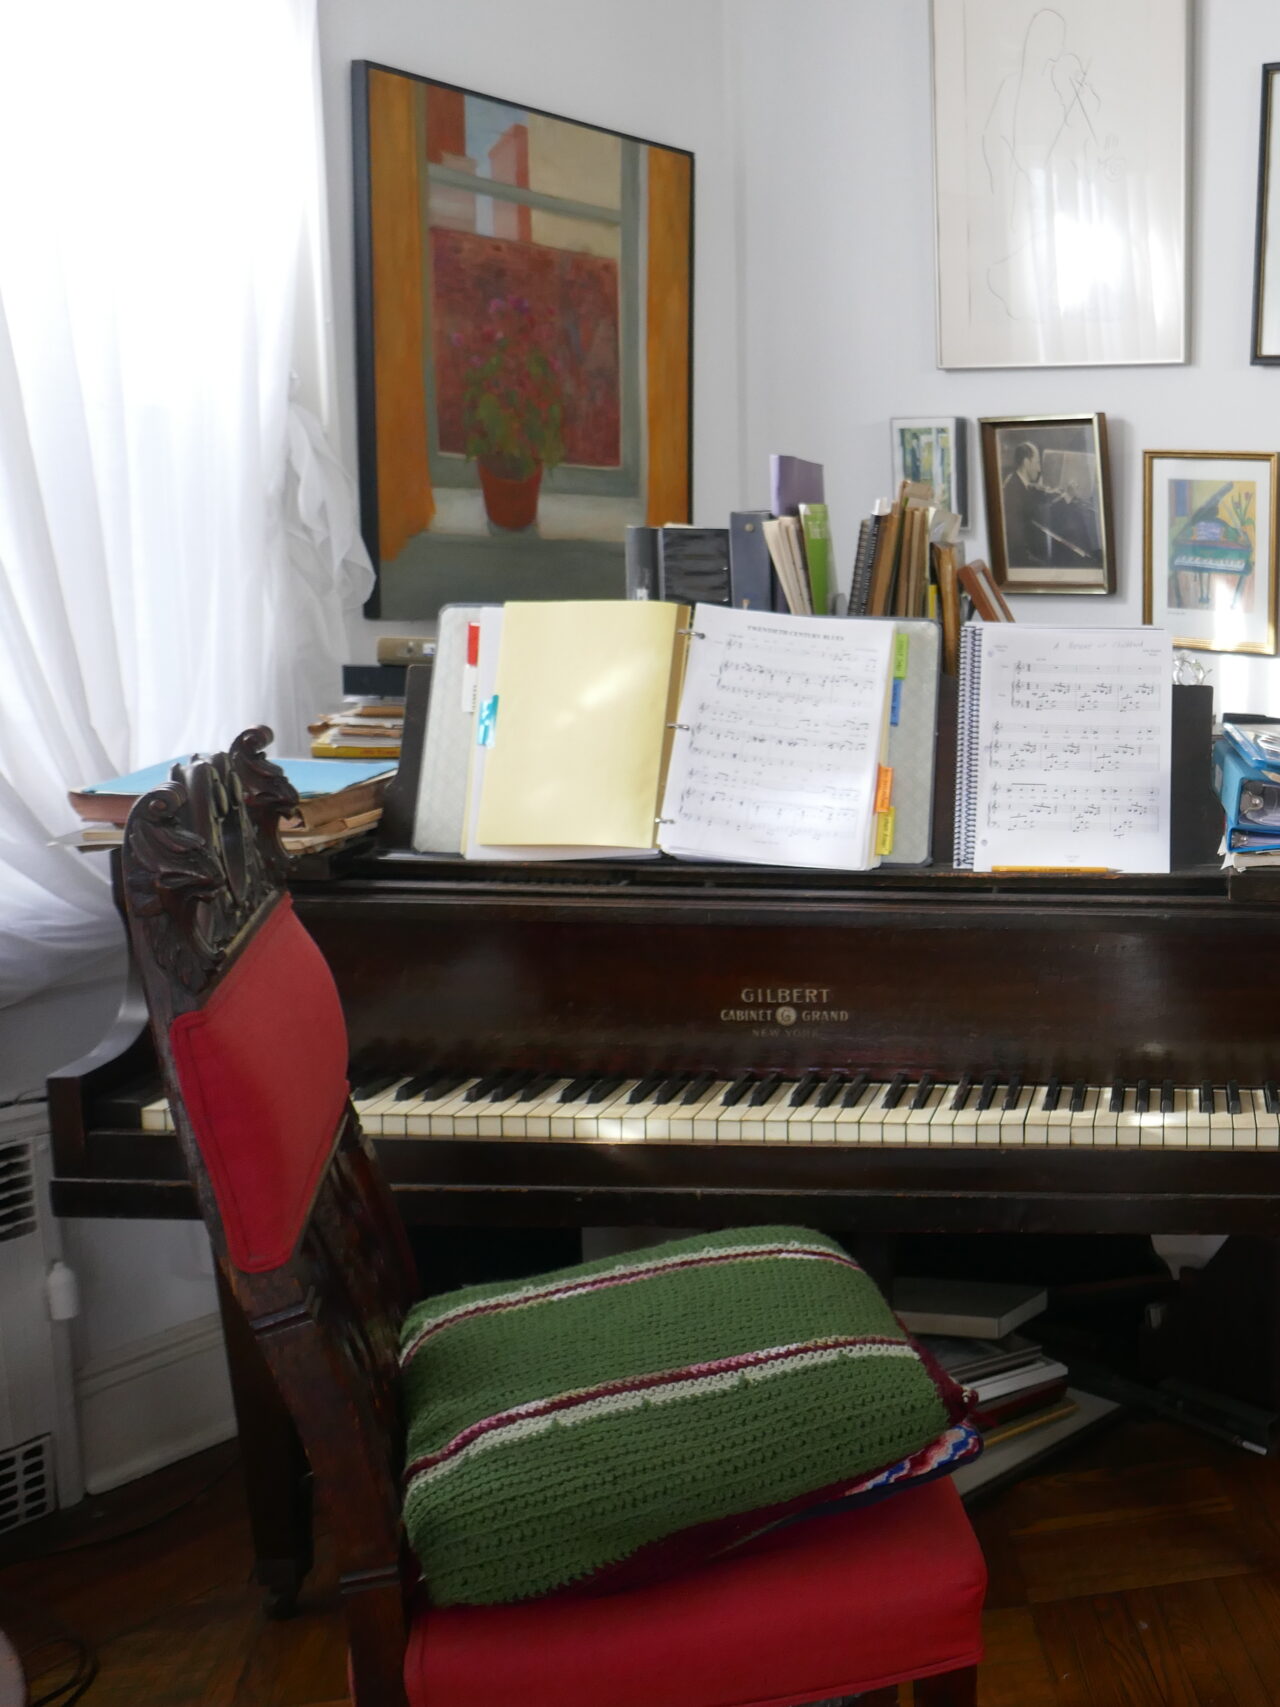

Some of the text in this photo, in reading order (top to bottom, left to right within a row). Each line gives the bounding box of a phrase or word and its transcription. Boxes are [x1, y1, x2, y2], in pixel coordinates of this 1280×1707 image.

[740, 988, 832, 1003] GILBERT
[720, 1009, 773, 1022] CABINET
[802, 1010, 849, 1022] GRAND
[752, 1029, 820, 1038] NEW YORK
